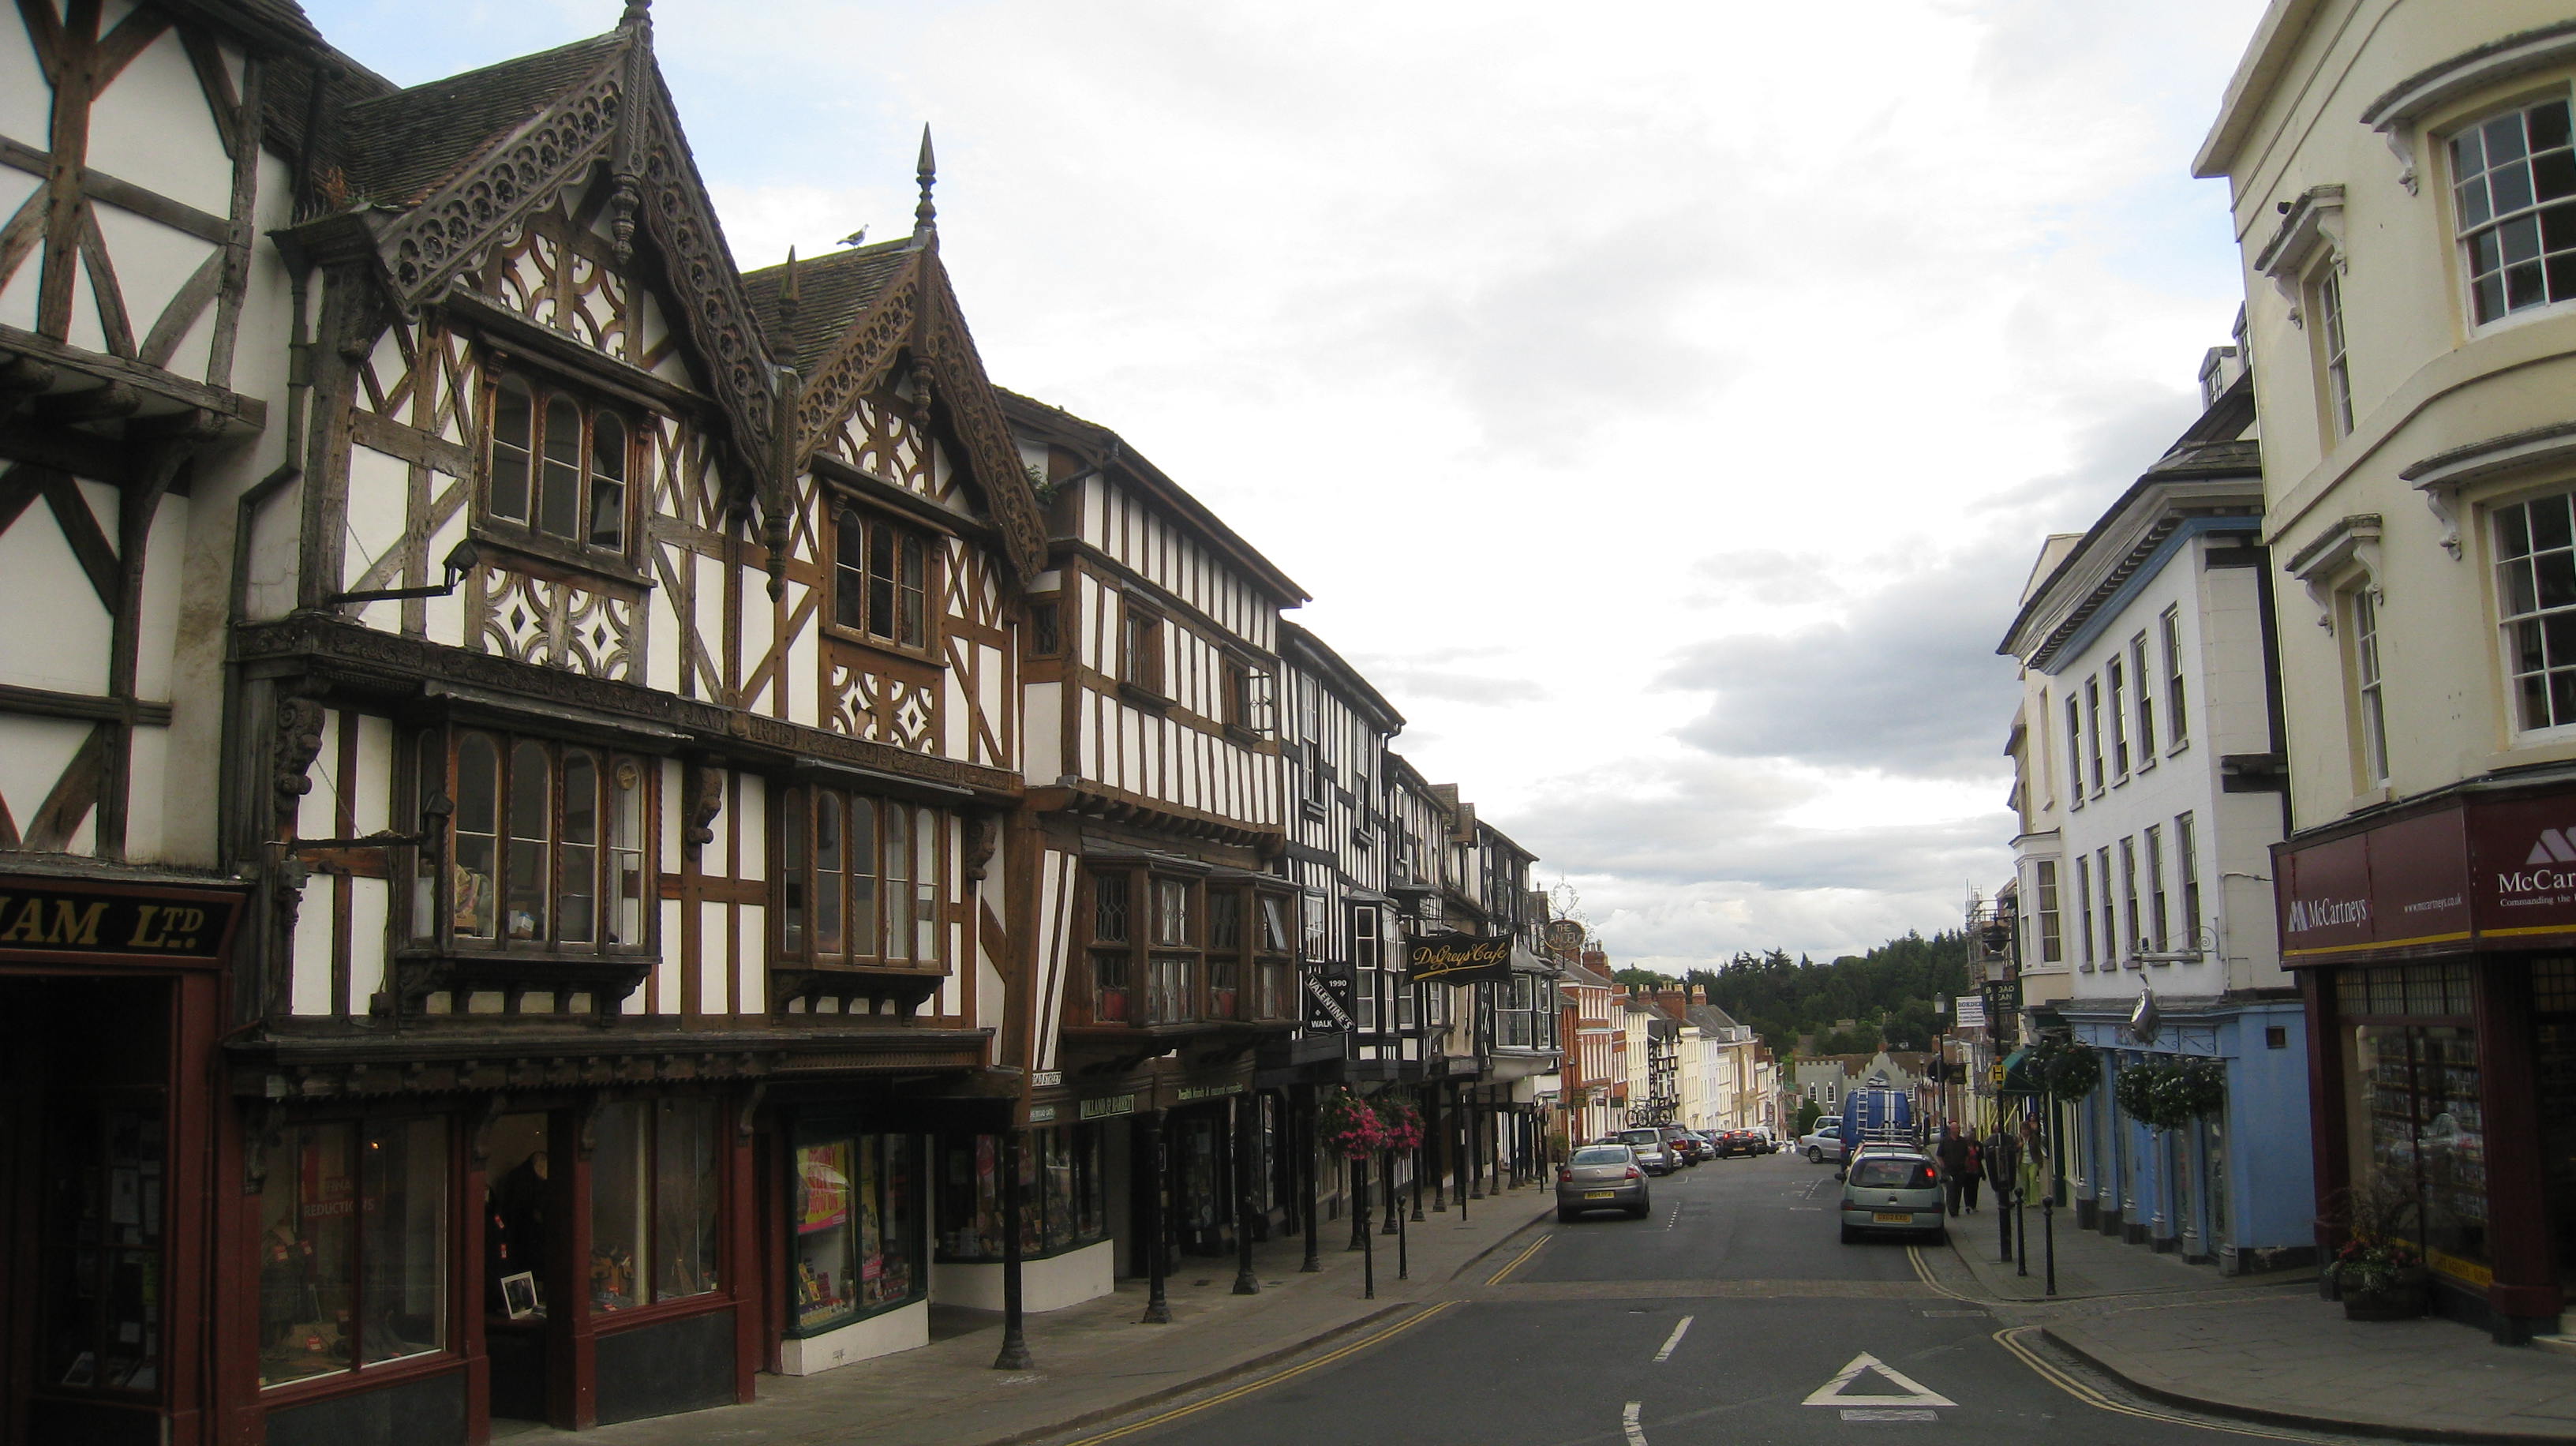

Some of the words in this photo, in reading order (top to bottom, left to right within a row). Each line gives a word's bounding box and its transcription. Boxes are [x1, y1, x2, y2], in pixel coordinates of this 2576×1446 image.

[2500, 896, 2554, 907] Commanding
[2557, 893, 2571, 903] the
[2308, 897, 2367, 927] McCartneys
[1555, 923, 1571, 933] THE
[1328, 979, 1347, 987] 1990
[1985, 984, 2015, 995] BOAD
[1309, 977, 1353, 1030] VALENTINE'S
[1311, 1019, 1333, 1028] WALK
[1993, 1066, 2004, 1080] H
[327, 1179, 351, 1191] FINA
[303, 1199, 375, 1218] REDUCTIS
